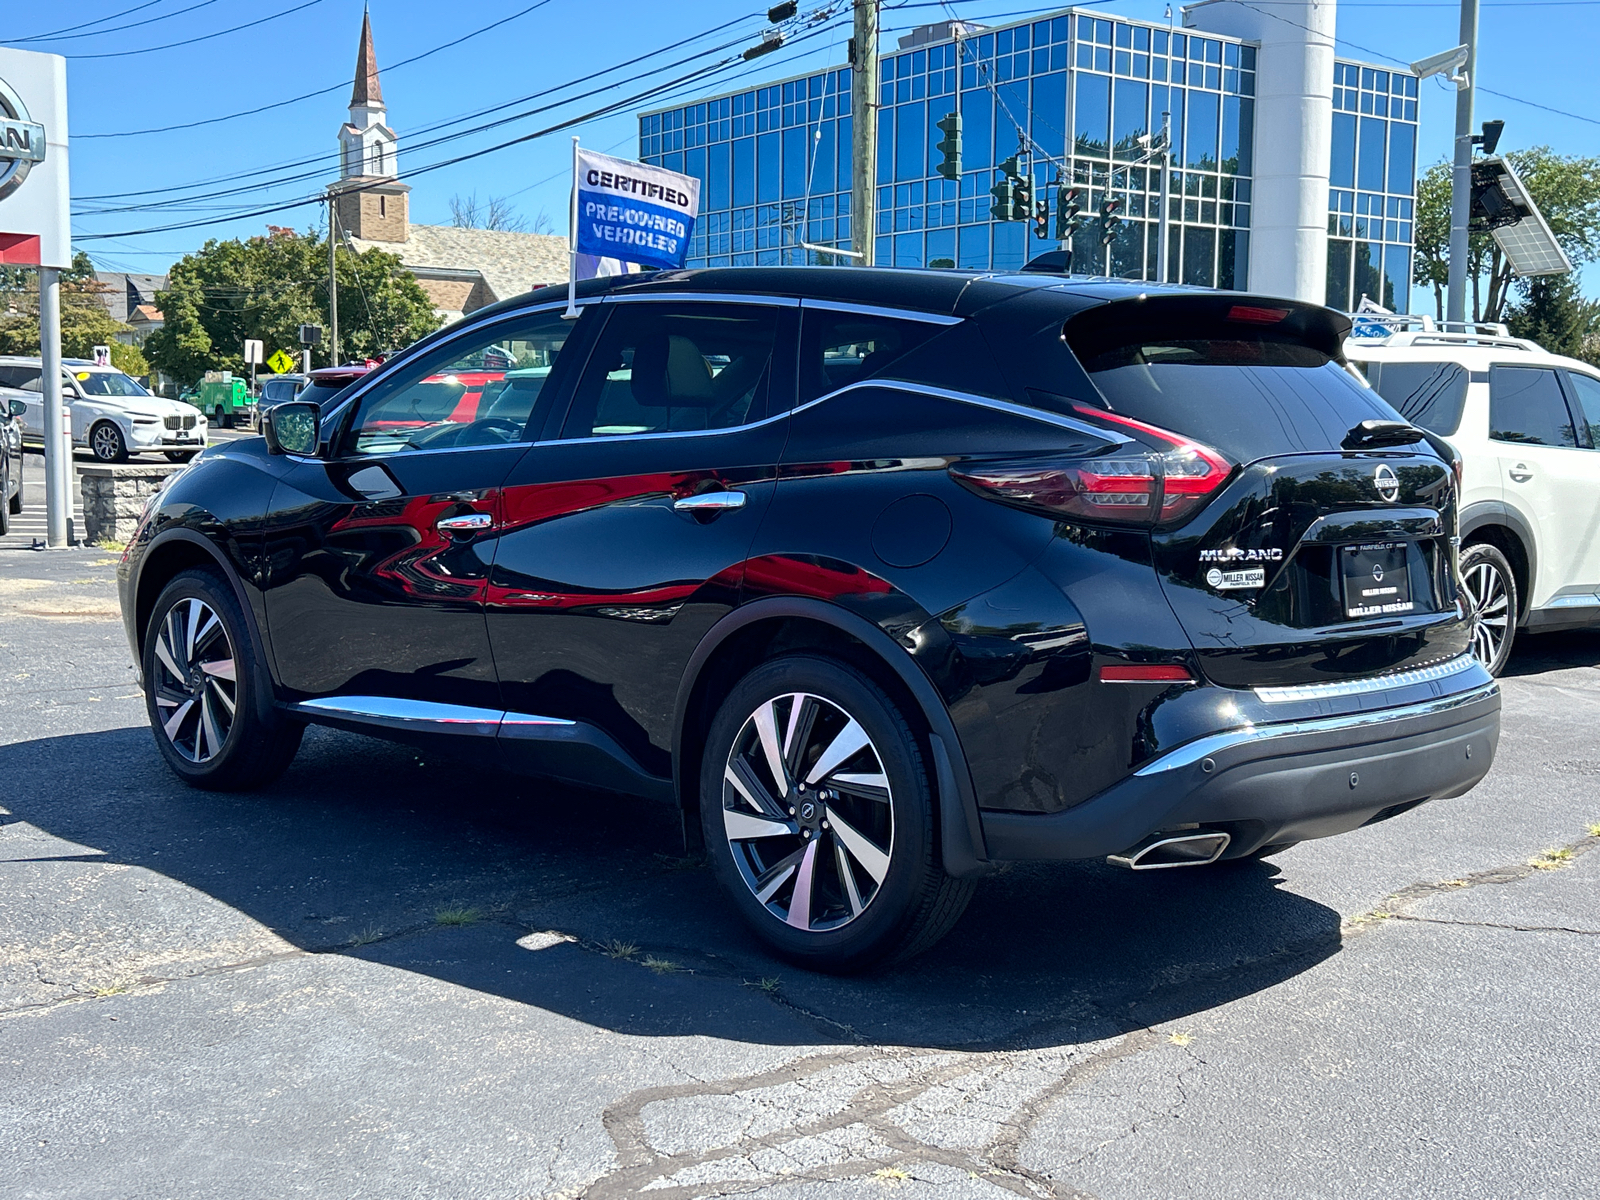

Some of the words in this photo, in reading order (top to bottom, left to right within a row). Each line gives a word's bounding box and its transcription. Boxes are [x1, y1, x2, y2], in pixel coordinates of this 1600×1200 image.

[586, 169, 689, 208] CERTIFIED
[586, 202, 686, 239] PRE-OWNED
[592, 223, 678, 255] VEHICLES
[1199, 548, 1283, 562] MURANO
[1223, 574, 1243, 582] MILLER
[1245, 573, 1263, 581] NISSAN
[1348, 606, 1382, 617] MILLER
[1382, 602, 1414, 613] NISSAN
